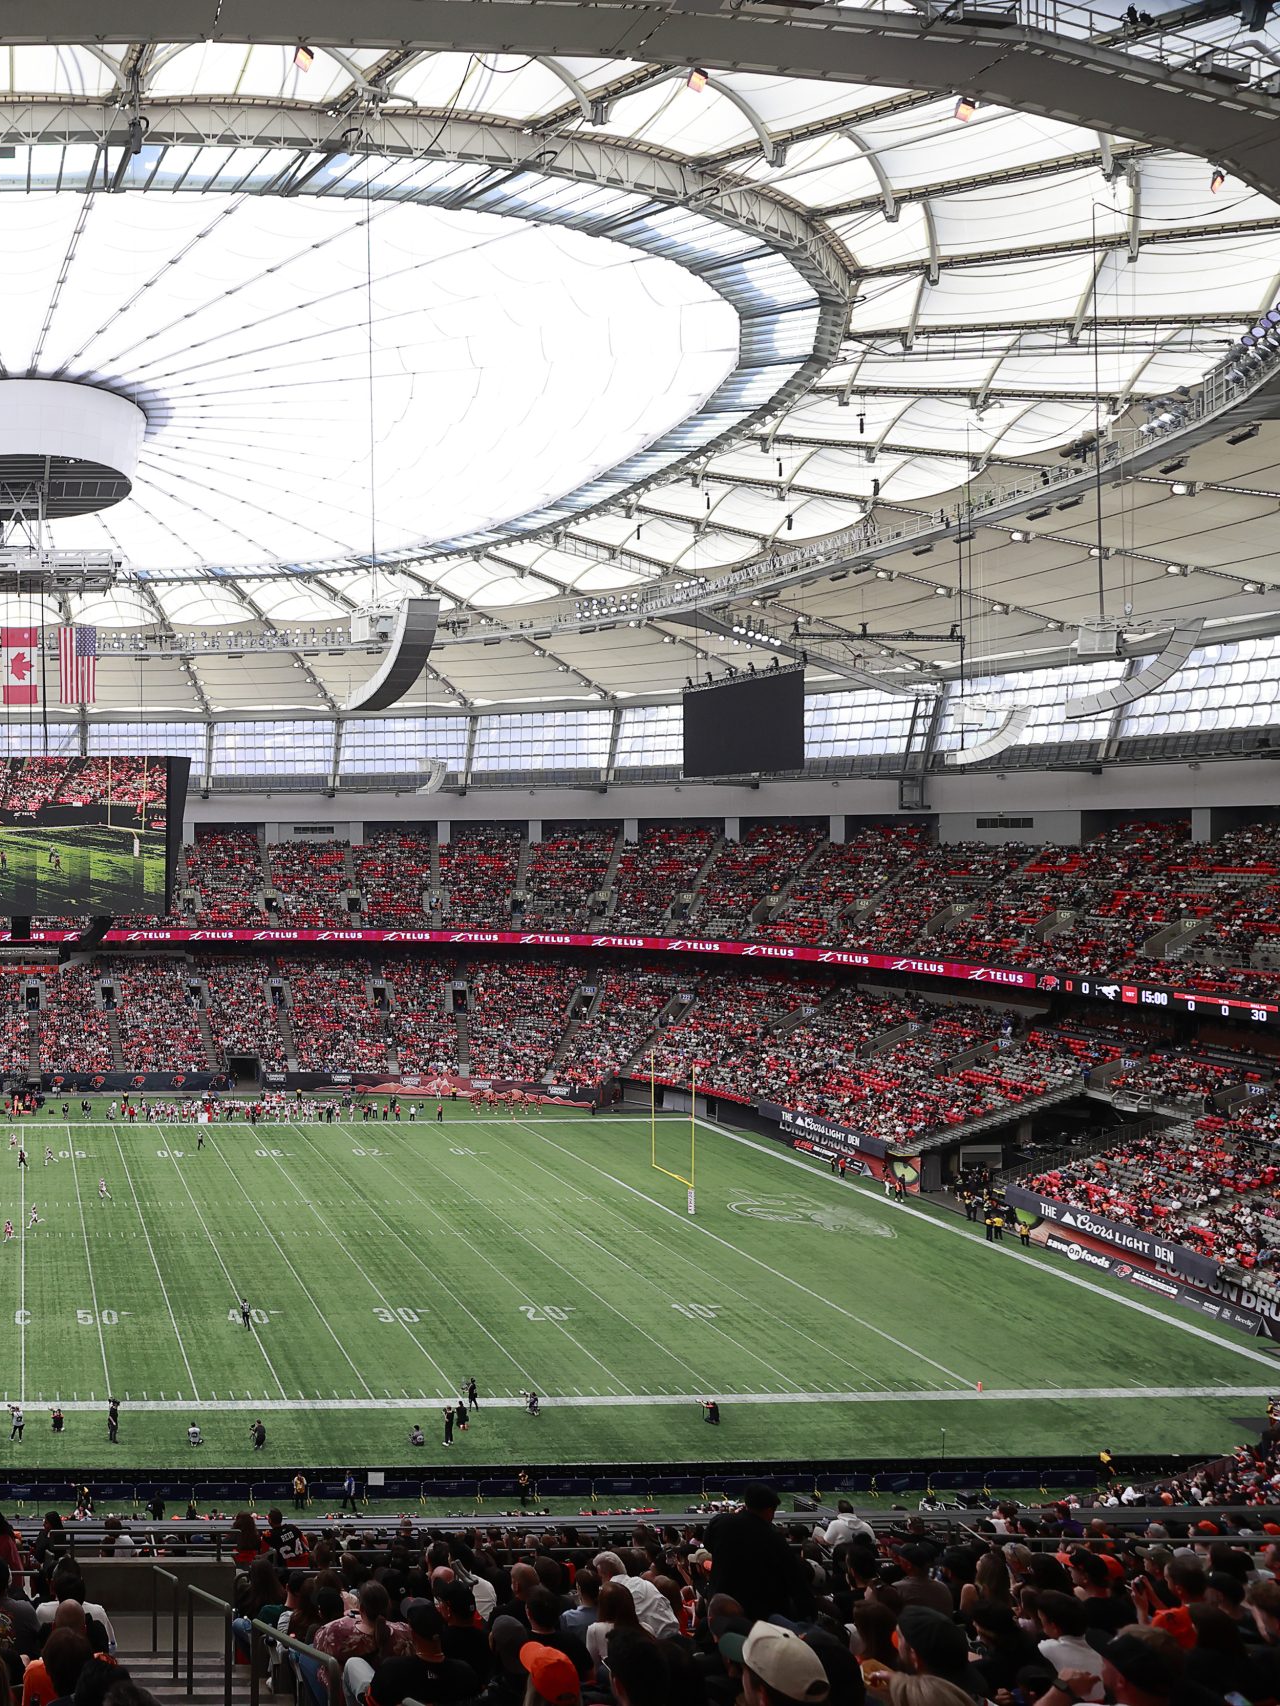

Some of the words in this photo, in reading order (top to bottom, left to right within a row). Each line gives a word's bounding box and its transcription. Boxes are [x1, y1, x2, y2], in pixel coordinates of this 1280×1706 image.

[142, 931, 171, 939] TELUS
[204, 930, 234, 939] TELUS
[268, 930, 298, 939] TELUS
[333, 931, 363, 939] TELUS
[399, 931, 431, 940] TELUS
[466, 932, 499, 942] TELUS
[538, 934, 571, 944] TELUS
[610, 936, 644, 947] TELUS
[685, 940, 720, 951] TELUS
[760, 945, 794, 957] TELUS
[835, 951, 869, 965] TELUS
[910, 959, 944, 973] TELUS
[989, 968, 1024, 984] TELUS
[1065, 980, 1073, 992] 0
[1081, 982, 1089, 994] 0
[1141, 990, 1168, 1005] 15:00
[1187, 1000, 1195, 1011] 0
[1221, 1005, 1229, 1016] 0
[1250, 1009, 1267, 1022] 30
[781, 1111, 793, 1122] THE
[804, 1116, 825, 1133] Coors
[825, 1128, 845, 1142] LIGHT
[847, 1134, 860, 1147] DEN
[779, 1121, 819, 1143] LONDON
[820, 1135, 855, 1156] DRUGS
[57, 1150, 86, 1158] 50
[156, 1150, 184, 1158] 40
[254, 1149, 283, 1157] 30
[350, 1148, 384, 1156] 20
[448, 1147, 476, 1155] 10
[1040, 1202, 1057, 1219] THE
[1076, 1213, 1113, 1240] Coors
[1114, 1232, 1150, 1254] LIGHT
[1154, 1244, 1174, 1265] DEN
[1046, 1238, 1068, 1252] save
[1080, 1249, 1110, 1269] foods
[14, 1309, 30, 1325] C
[75, 1309, 118, 1325] 50
[227, 1308, 269, 1324] 40
[371, 1307, 419, 1322] 30
[518, 1305, 569, 1321] 20
[670, 1303, 718, 1319] 10
[280, 1531, 294, 1542] REID
